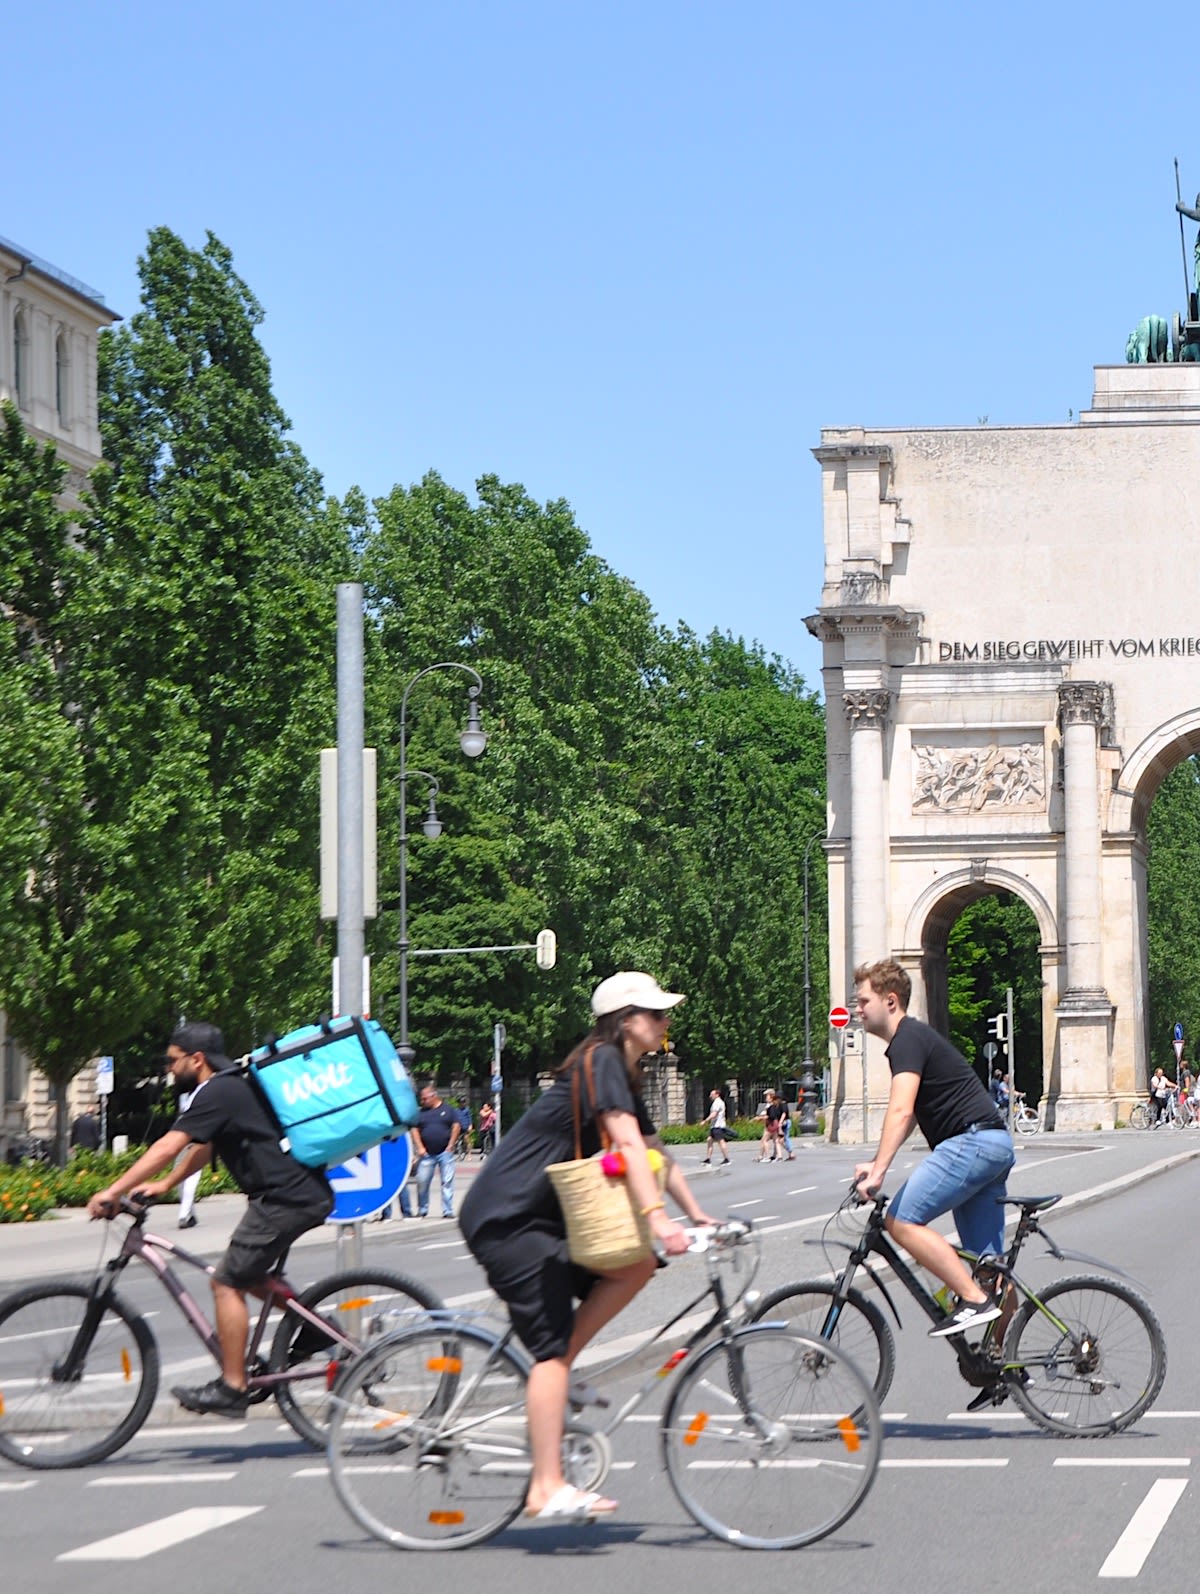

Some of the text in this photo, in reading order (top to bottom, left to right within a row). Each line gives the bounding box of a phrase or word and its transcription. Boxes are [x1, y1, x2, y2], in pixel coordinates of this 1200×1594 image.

[940, 641, 979, 662] DEM
[983, 640, 1021, 661] SIEG
[1023, 639, 1104, 660] GEWEIHT
[1109, 637, 1154, 658] VOM
[282, 1062, 353, 1105] Wolt
